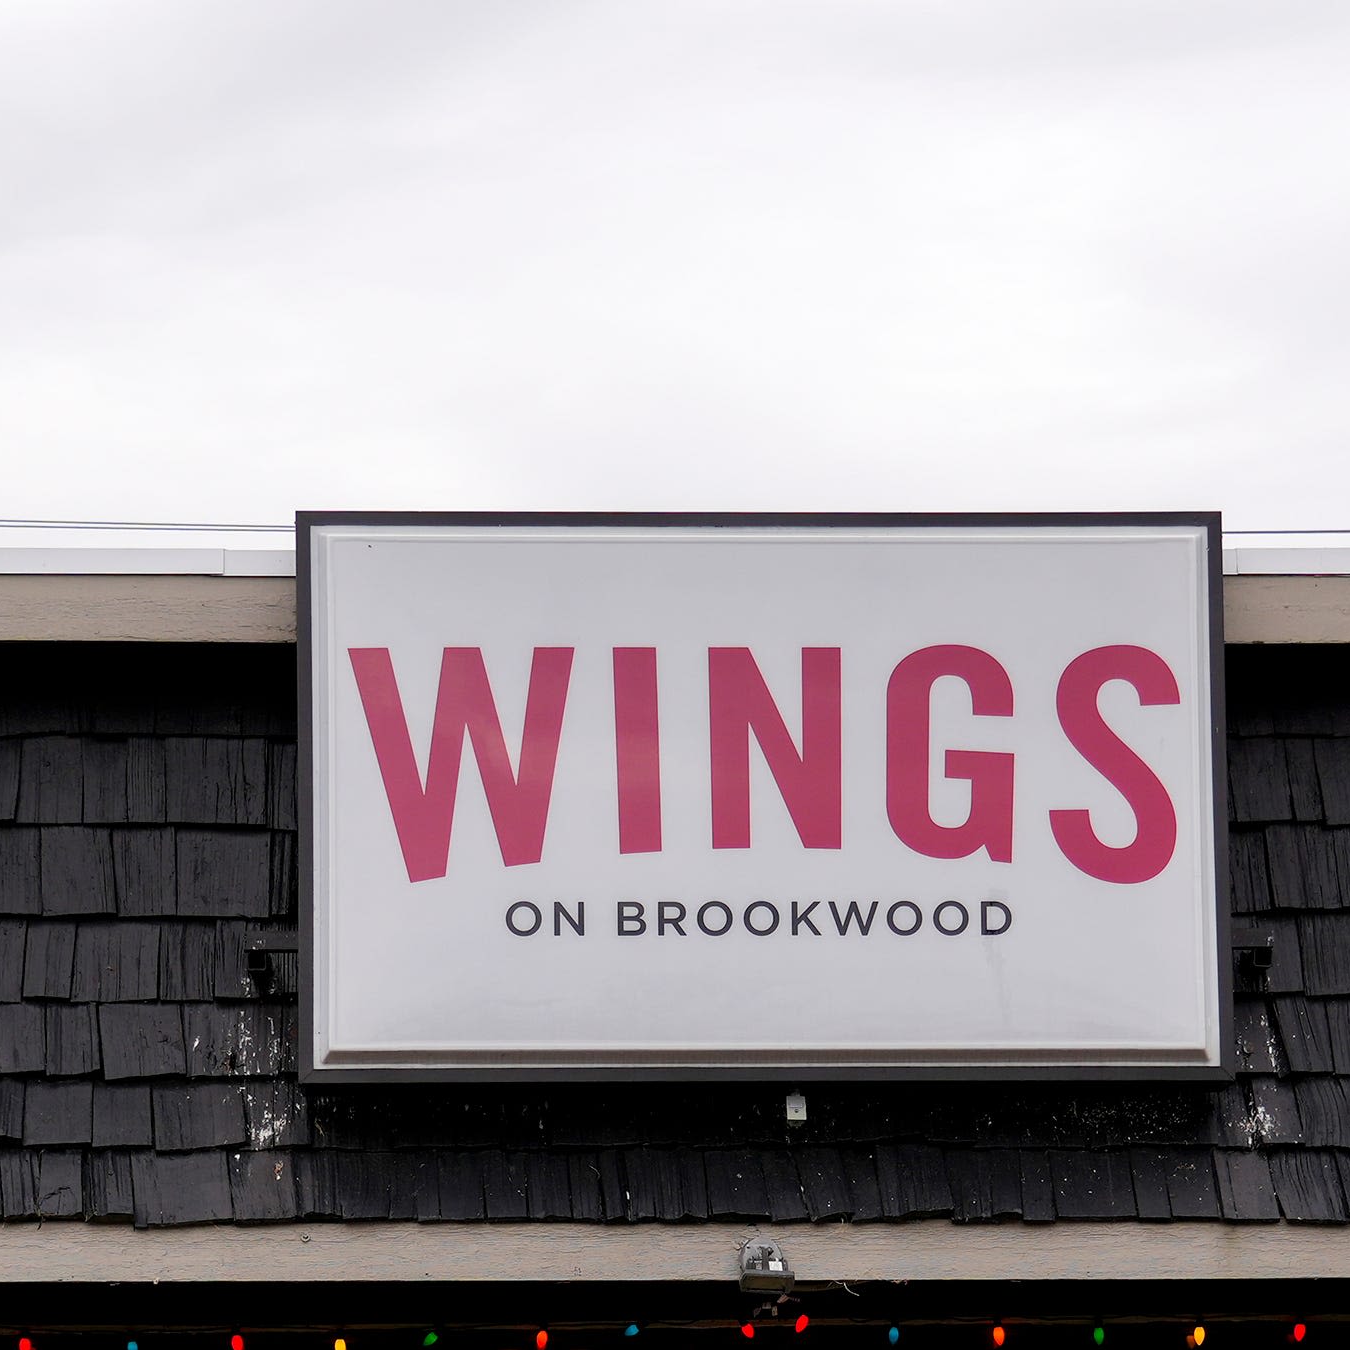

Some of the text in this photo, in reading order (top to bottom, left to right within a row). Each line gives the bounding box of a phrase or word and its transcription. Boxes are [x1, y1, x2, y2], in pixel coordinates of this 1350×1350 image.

[347, 643, 1181, 884] WINGS
[505, 900, 1014, 937] ON BROOKWOOD
